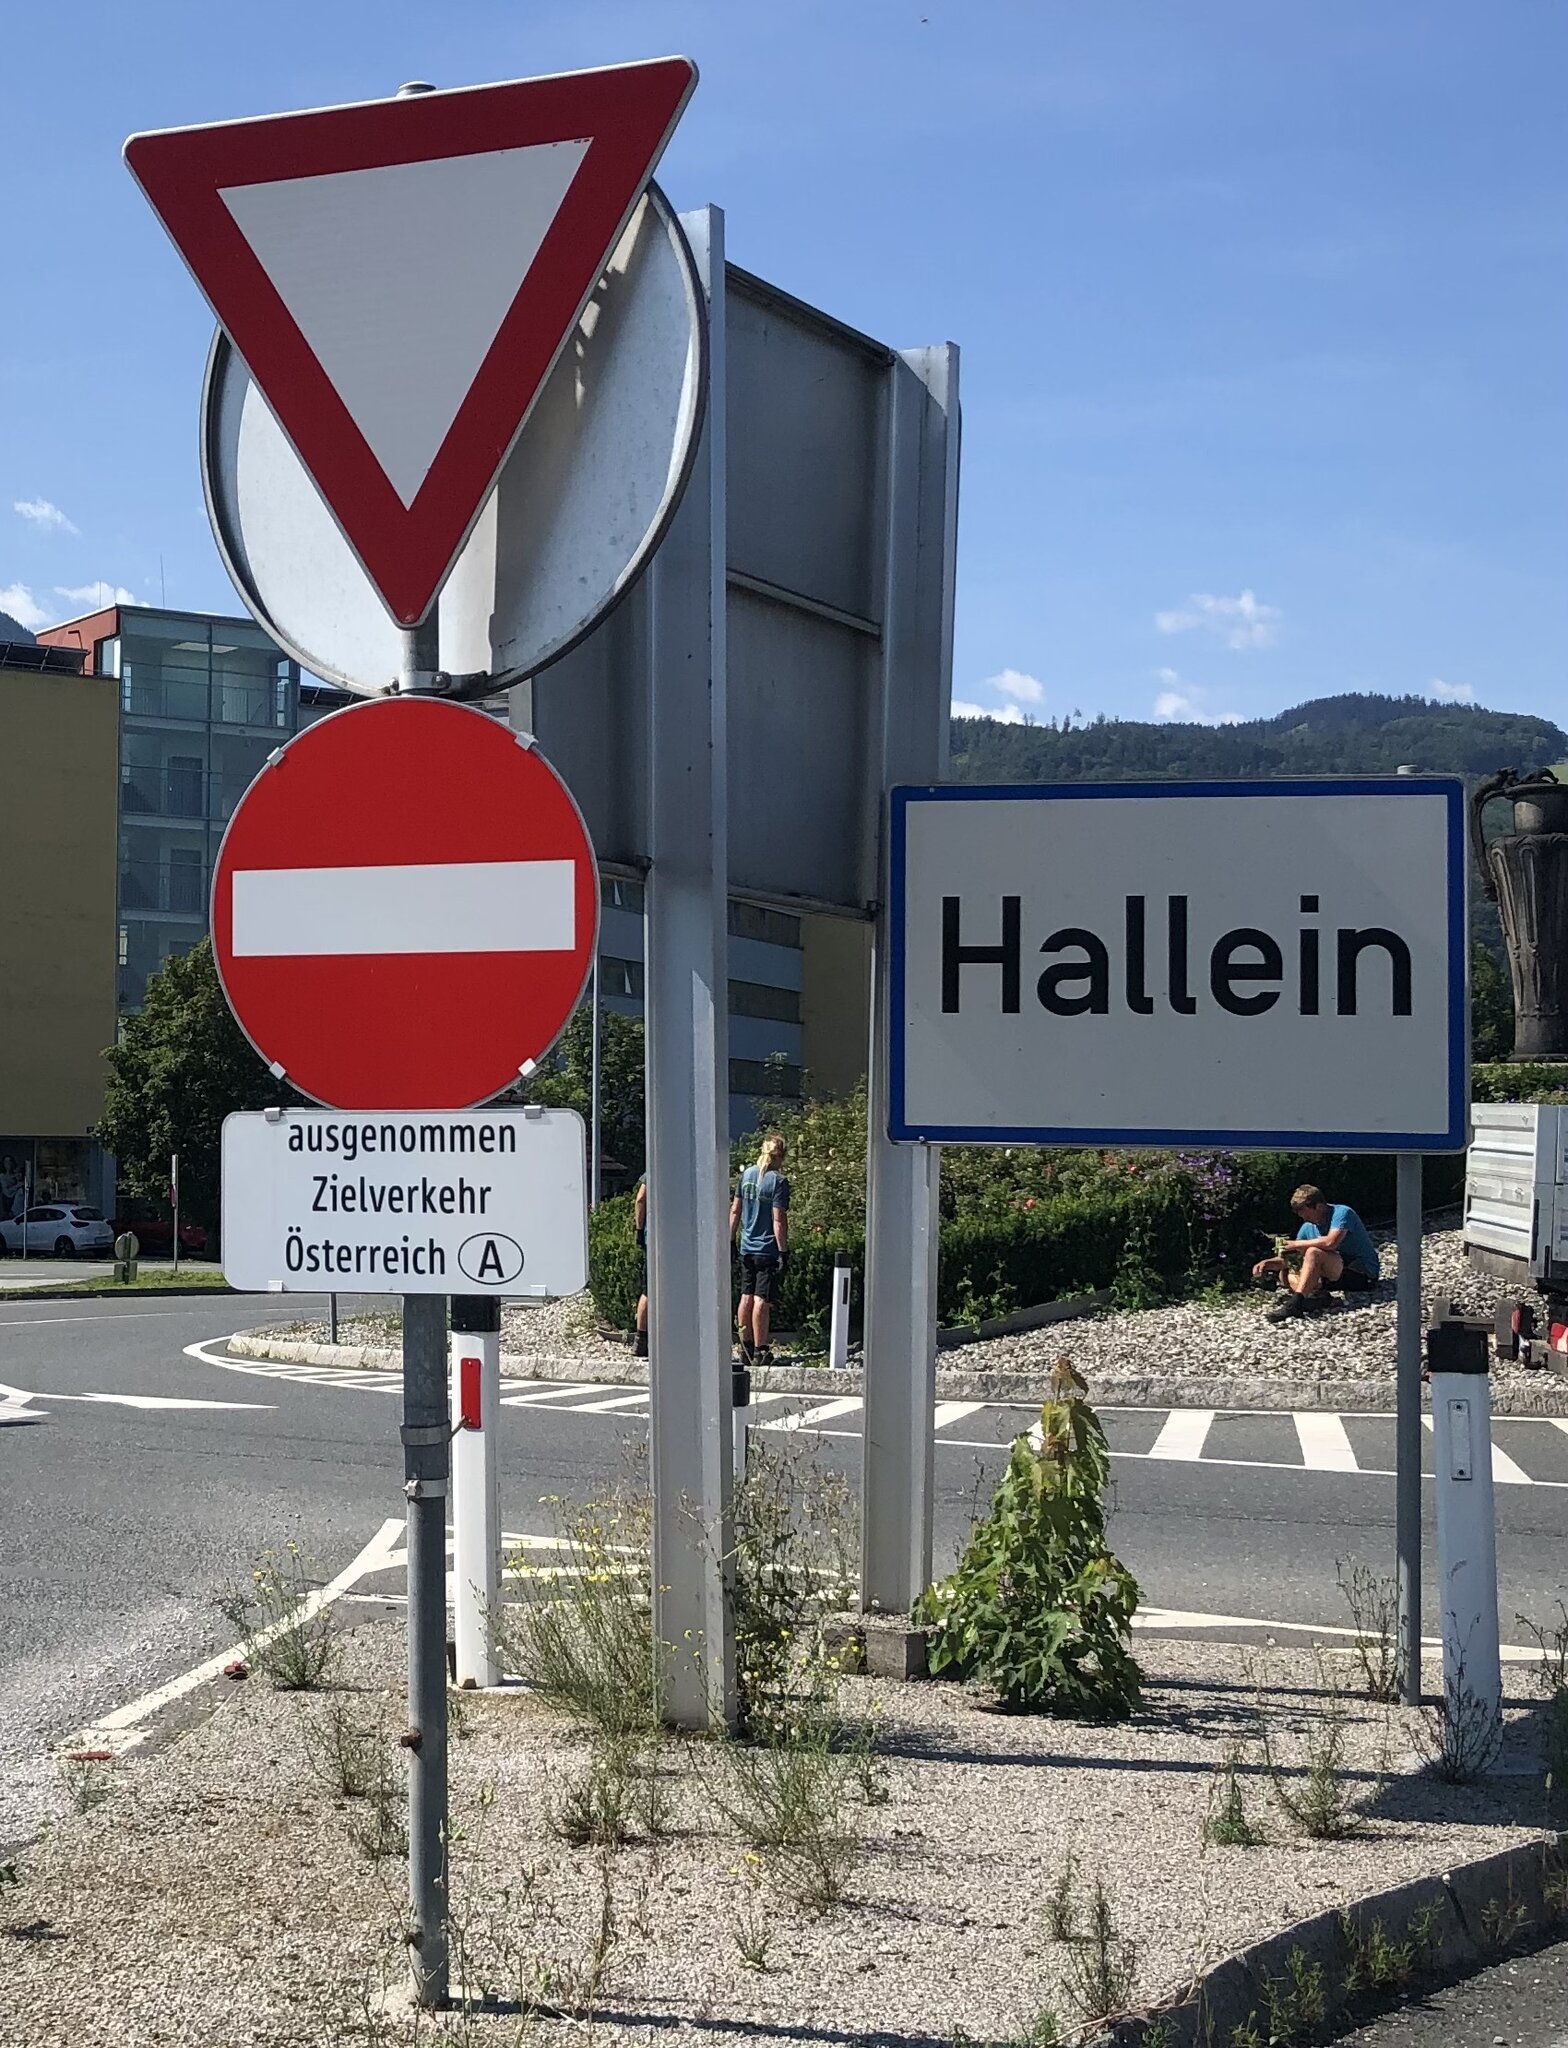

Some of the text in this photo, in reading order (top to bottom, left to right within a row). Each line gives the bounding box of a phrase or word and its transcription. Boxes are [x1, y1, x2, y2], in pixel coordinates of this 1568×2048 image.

[941, 895, 1413, 1016] Hallein
[288, 1123, 516, 1161] ausgenommen
[312, 1173, 492, 1215] Zielverkehr
[285, 1226, 505, 1279] Österreich A
